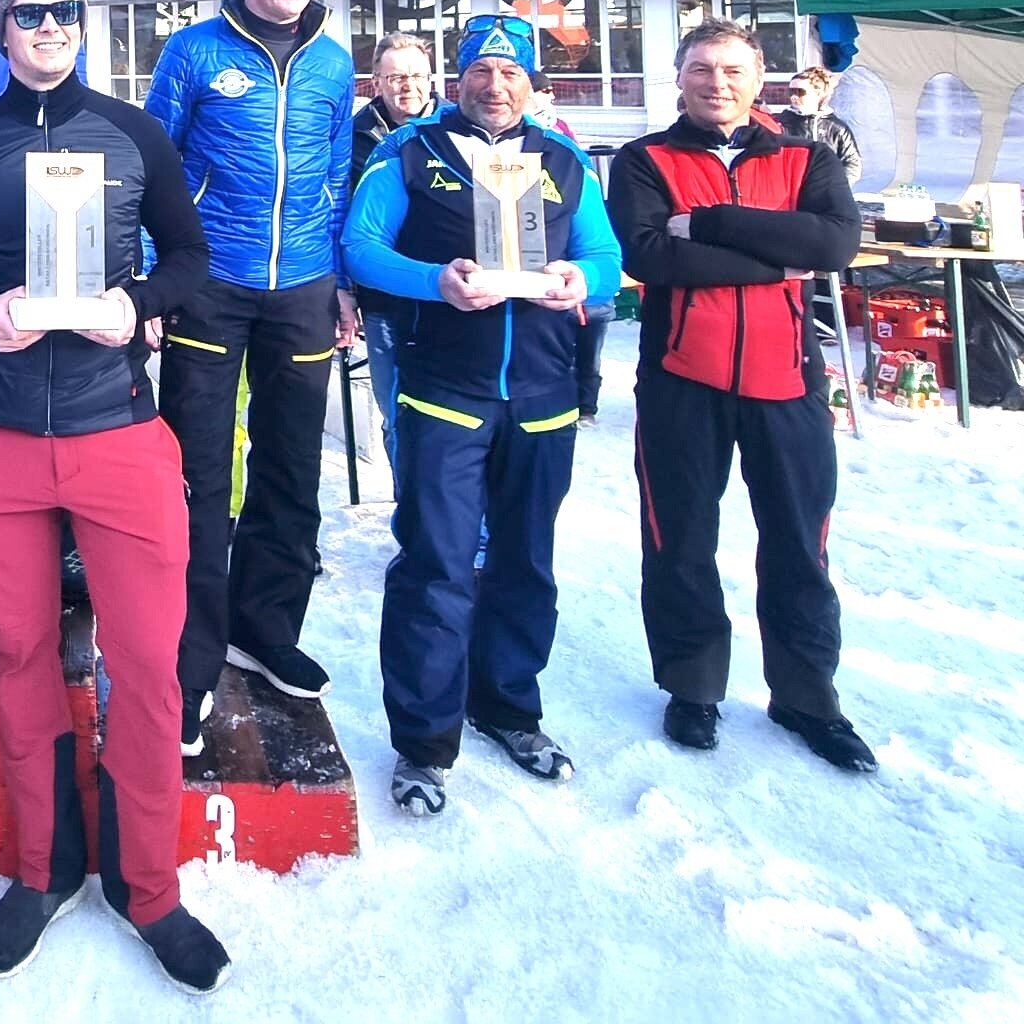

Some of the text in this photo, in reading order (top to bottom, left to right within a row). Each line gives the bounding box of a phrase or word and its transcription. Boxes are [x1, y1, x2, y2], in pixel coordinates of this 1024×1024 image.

[524, 211, 538, 231] 3
[86, 225, 95, 248] 1
[205, 793, 236, 869] 3
